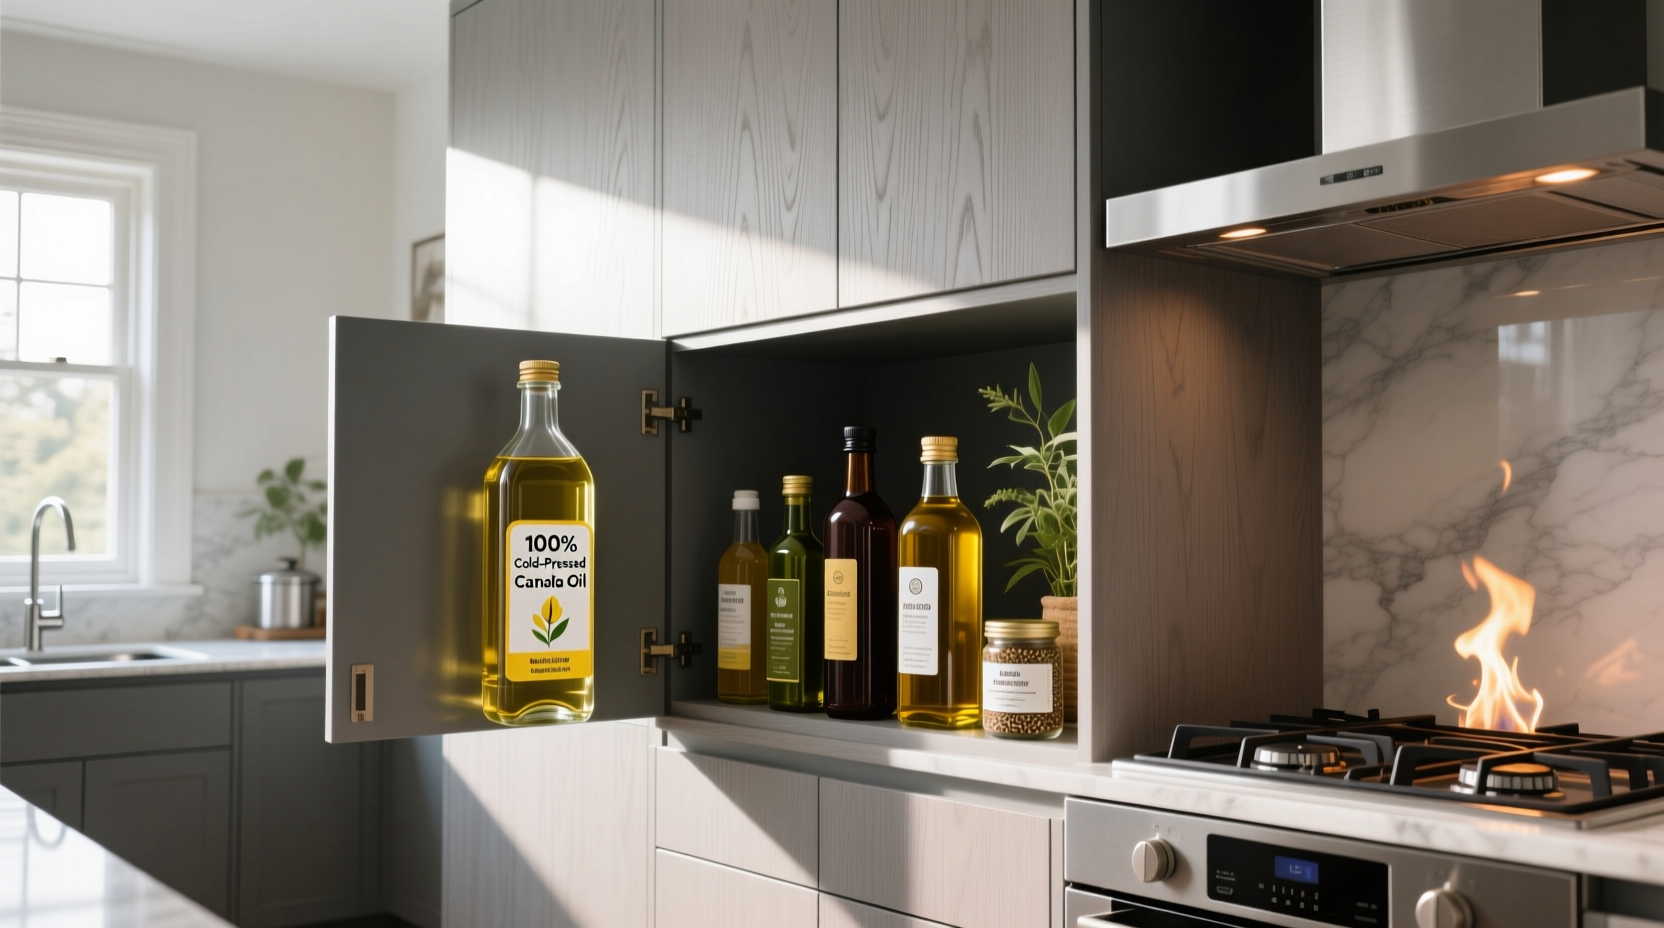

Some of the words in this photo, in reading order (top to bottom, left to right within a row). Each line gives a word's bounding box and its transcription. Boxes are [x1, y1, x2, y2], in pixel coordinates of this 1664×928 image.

[525, 534, 578, 552] 100%
[514, 556, 586, 569] Cold-Pressed
[567, 573, 587, 588] Oil
